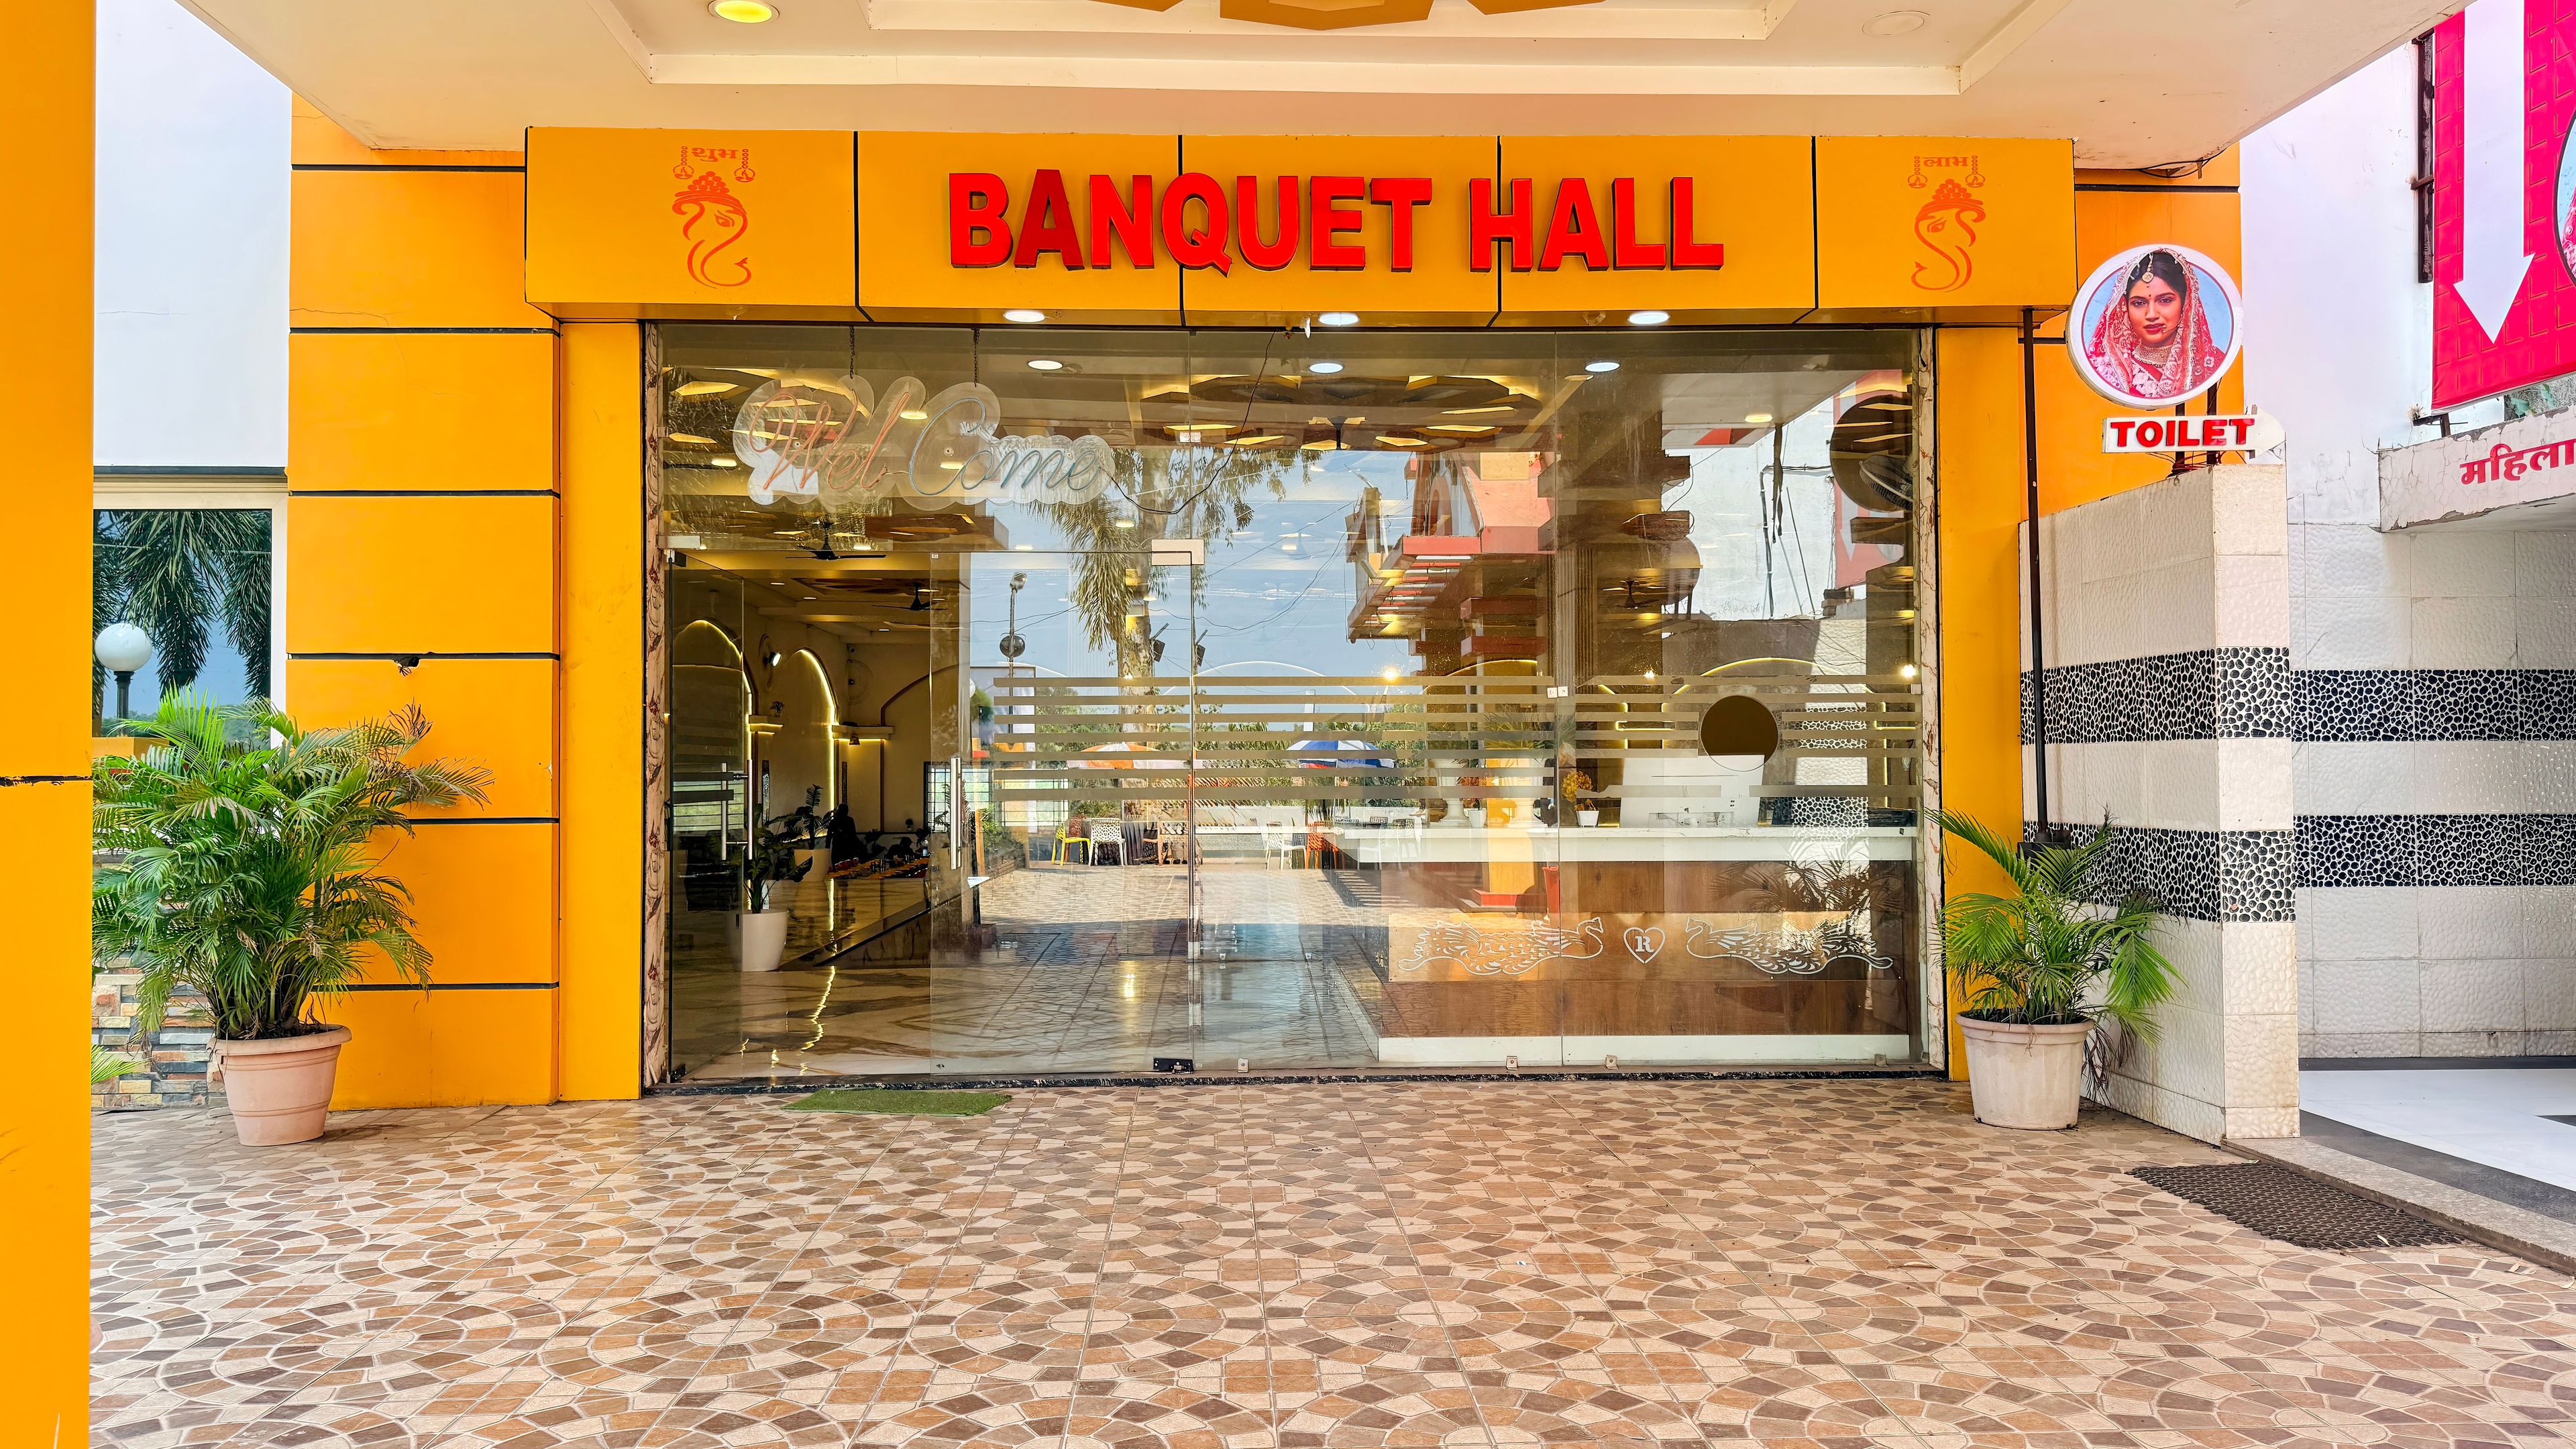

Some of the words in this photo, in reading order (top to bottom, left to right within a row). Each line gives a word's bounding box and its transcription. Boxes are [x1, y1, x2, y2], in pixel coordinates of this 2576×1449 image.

[691, 147, 739, 162] शुभ
[1921, 156, 1970, 168] लाभ
[949, 168, 1434, 276] BANQUET
[1469, 177, 1725, 272] HALL
[749, 388, 910, 491] Wel
[908, 396, 1102, 496] Come
[2110, 418, 2255, 448] TOILET
[2459, 438, 2576, 485] महिला
[1635, 934, 1654, 953] R
